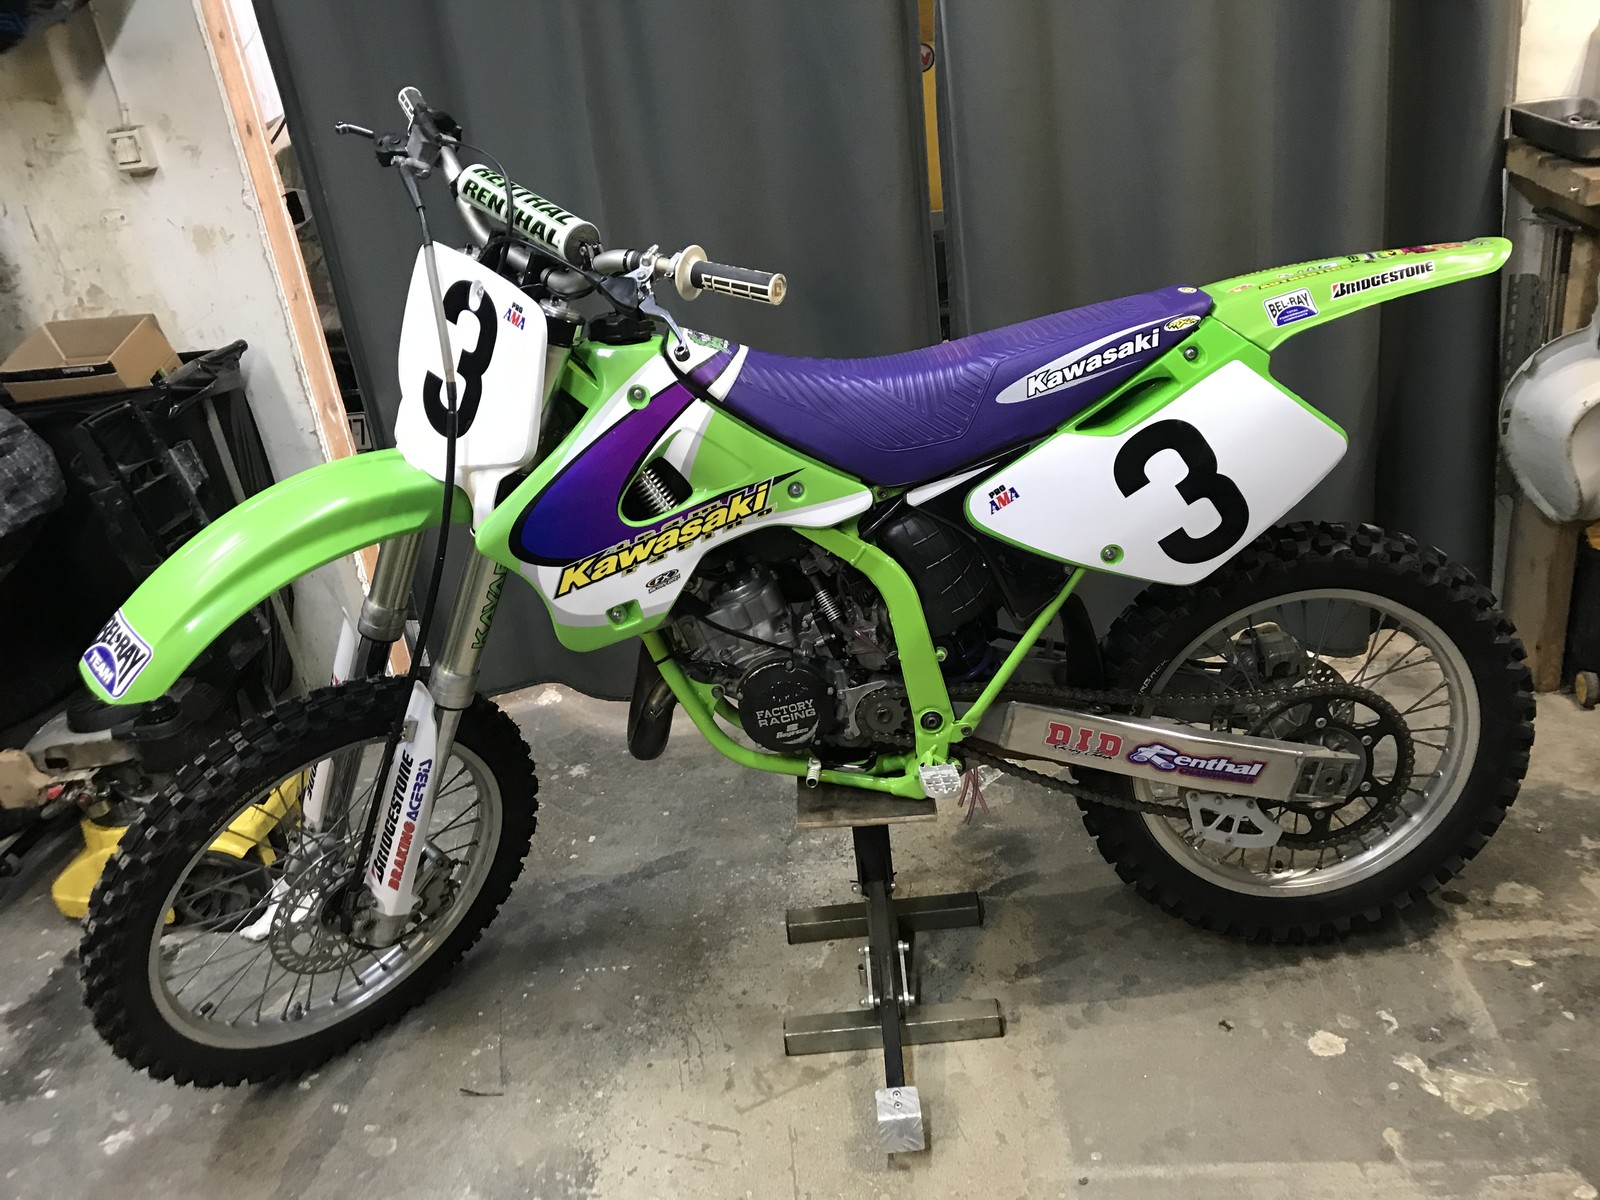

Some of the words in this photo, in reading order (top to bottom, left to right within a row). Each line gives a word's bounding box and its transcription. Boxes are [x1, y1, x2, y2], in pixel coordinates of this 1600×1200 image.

[1332, 261, 1435, 299] BRIDGESTONE
[503, 308, 526, 331] AMA
[511, 301, 524, 314] PRO
[1267, 292, 1310, 319] BEL-RAY
[422, 279, 498, 439] 3
[1026, 327, 1160, 398] Kawasaki
[988, 484, 1006, 499] PRO
[989, 487, 1020, 515] AMA
[1113, 419, 1250, 564] 3
[553, 478, 773, 600] Kawasaki
[87, 648, 115, 685] TEAM
[755, 699, 814, 720] FACTORY
[758, 708, 817, 728] RACING
[1129, 744, 1264, 776] Renthal
[371, 749, 415, 886] BRIDGESTONE
[388, 820, 416, 892] BRAKING
